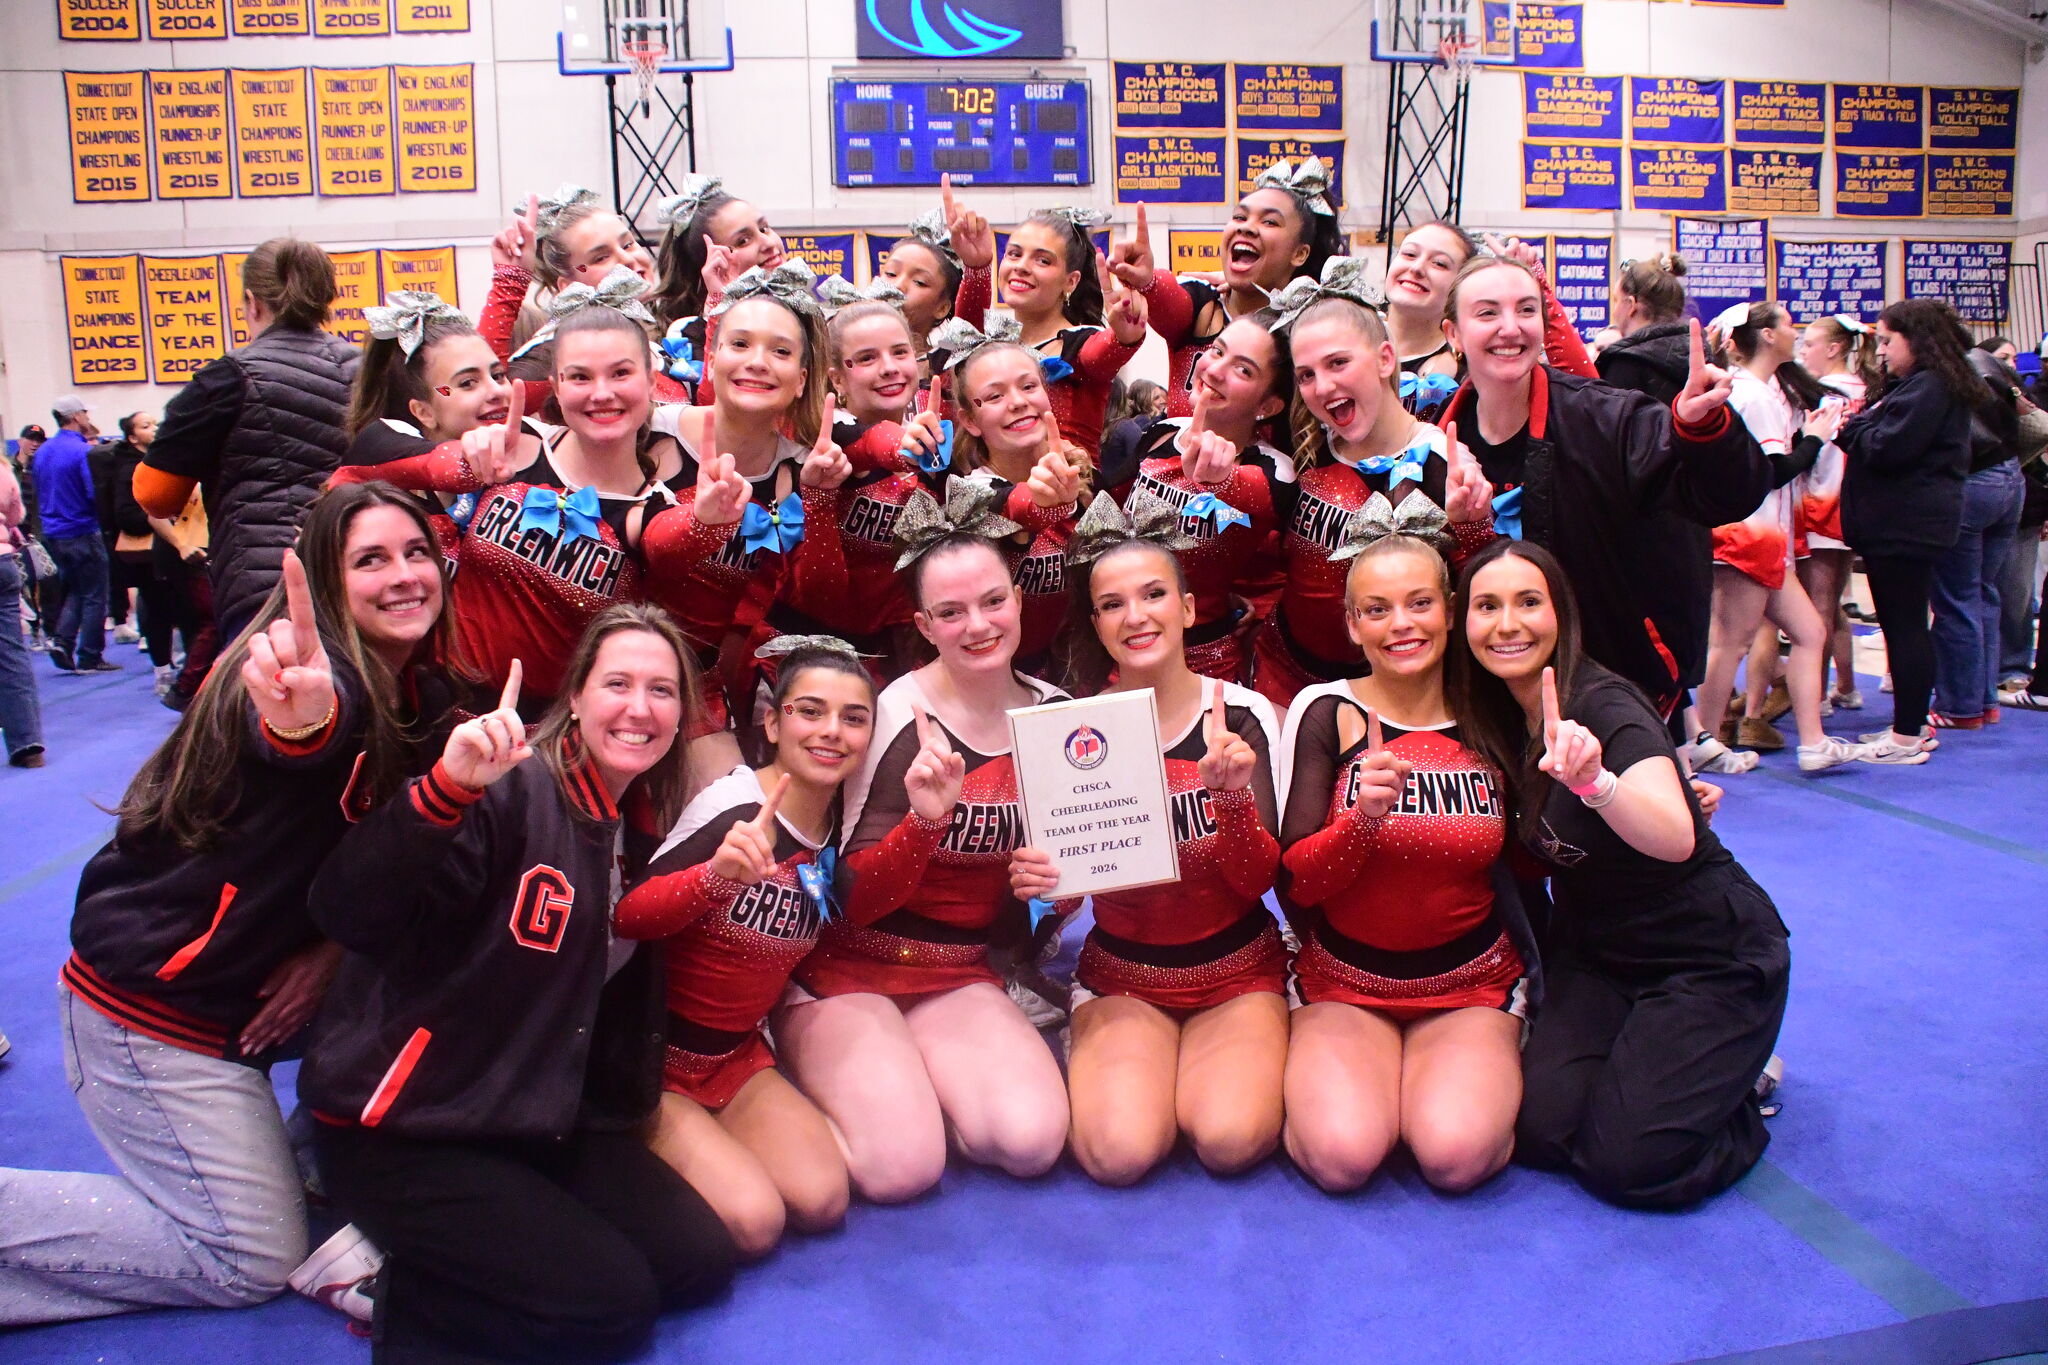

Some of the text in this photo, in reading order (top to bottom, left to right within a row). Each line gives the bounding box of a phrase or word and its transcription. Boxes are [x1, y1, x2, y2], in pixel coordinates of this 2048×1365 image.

[411, 5, 452, 19] 2011
[70, 16, 129, 31] 2004
[159, 16, 216, 30] 2004
[243, 13, 299, 27] 2005
[324, 13, 380, 27] 2005
[153, 81, 223, 95] NEW ENGLAND
[241, 79, 295, 93] CONNECTICUT
[325, 79, 377, 93] CONNECTICUT
[399, 75, 469, 89] NEW ENGLAND
[1125, 77, 1216, 89] CHAMPIONS
[1244, 79, 1333, 92] CHAMPIONS
[77, 83, 132, 97] CONNECTICUT
[856, 85, 893, 99] HOME
[1024, 84, 1065, 99] GUEST
[1124, 90, 1217, 102] BOYS SOCCER
[1536, 88, 1612, 102] CHAMPIONS
[403, 98, 466, 111] CHAMPIONSHIPS
[947, 88, 995, 114] 7:02
[1242, 92, 1337, 104] BOYS CROSS COUNTRY
[1640, 91, 1717, 105] CHAMPIONS
[1741, 95, 1818, 108] CHAMPIONS
[1841, 98, 1914, 110] CHAMPIONS
[76, 107, 138, 121] STATE OPEN
[159, 105, 220, 118] CHAMPIONSHIPS
[253, 104, 287, 117] STATE
[322, 101, 383, 115] STATE OPEN
[1538, 101, 1611, 115] BASEBALL
[1637, 104, 1720, 117] GYMNASTICS
[1740, 107, 1819, 120] INDOOR TRACK
[1937, 102, 2010, 113] CHAMPIONS
[1840, 110, 1916, 122] BOYS TRACK FIELD
[1938, 114, 2008, 126] VOLLEYBALL
[241, 127, 302, 140] CHAMPIONS
[321, 124, 386, 138] RUNNER-UP
[403, 120, 468, 134] RUNNER-UP
[76, 130, 140, 144] CHAMPIONS
[160, 128, 222, 142] RUNNER-UP
[325, 147, 384, 161] CHEERLEADING
[406, 143, 467, 156] WRESTLING
[79, 154, 141, 168] WRESTLING
[162, 151, 223, 165] WRESTLING
[243, 150, 304, 164] WRESTLING
[1125, 151, 1216, 164] CHAMPIONS
[1120, 165, 1221, 176] GIRLS BASKETBALL
[1534, 159, 1612, 172] CHAMPIONS
[1640, 162, 1716, 175] CHAMPIONS
[1738, 164, 1814, 178] CHAMPIONS
[251, 173, 300, 187] 2015
[332, 170, 382, 184] 2016
[411, 166, 463, 180] 2016
[1532, 172, 1615, 185] GIRLS SOCCER
[1846, 168, 1915, 179] CHAMPIONS
[1934, 168, 2007, 179] CHAMPIONS
[86, 177, 137, 191] 2015
[170, 174, 219, 188] 2015
[1649, 174, 1709, 187] GIRLS TENNIS
[1768, 178, 1812, 189] LACROSSE
[1872, 181, 1915, 192] LACROSSE
[1936, 180, 2004, 190] GIRLS TRACK
[1178, 245, 1221, 257] NEW ENGLA
[1784, 244, 1877, 255] SARAH HOULE
[1912, 244, 2003, 255] GIRLS TRACK FIELD
[392, 259, 443, 273] CONNECTICUT
[1814, 256, 1878, 267] CHAMPION
[1929, 256, 1956, 266] RELAY
[1961, 257, 1983, 267] TEAM
[74, 267, 125, 281] CONNECTICUT
[149, 267, 215, 281] CHEERLEADING
[1559, 265, 1605, 280] GATORADE
[1908, 268, 2006, 281] STATE OPEN CHAMPINS
[1912, 282, 1940, 294] CLASS
[86, 290, 120, 304] STATE
[156, 290, 211, 304] TEAM
[1790, 301, 1824, 312] GOLFER
[1826, 301, 1838, 311] OF
[1841, 301, 1858, 311] THE
[1862, 301, 1884, 311] YEAR
[74, 313, 135, 327] CHAMPIONS
[155, 313, 216, 327] OF THE
[73, 335, 140, 350] DANCE
[161, 336, 215, 349] YEAR
[81, 359, 136, 372] 2023
[162, 358, 215, 372] 202
[474, 494, 625, 599] GREENWICH
[1072, 781, 1112, 794] CHSCA
[1344, 762, 1502, 821] GENWICH
[1051, 796, 1138, 817] CHEERLEADING
[1044, 814, 1151, 838] TEAM OF THE YEAR
[1059, 836, 1142, 858] FIRST PLACE
[1090, 863, 1118, 875] 2026
[509, 863, 575, 953] G
